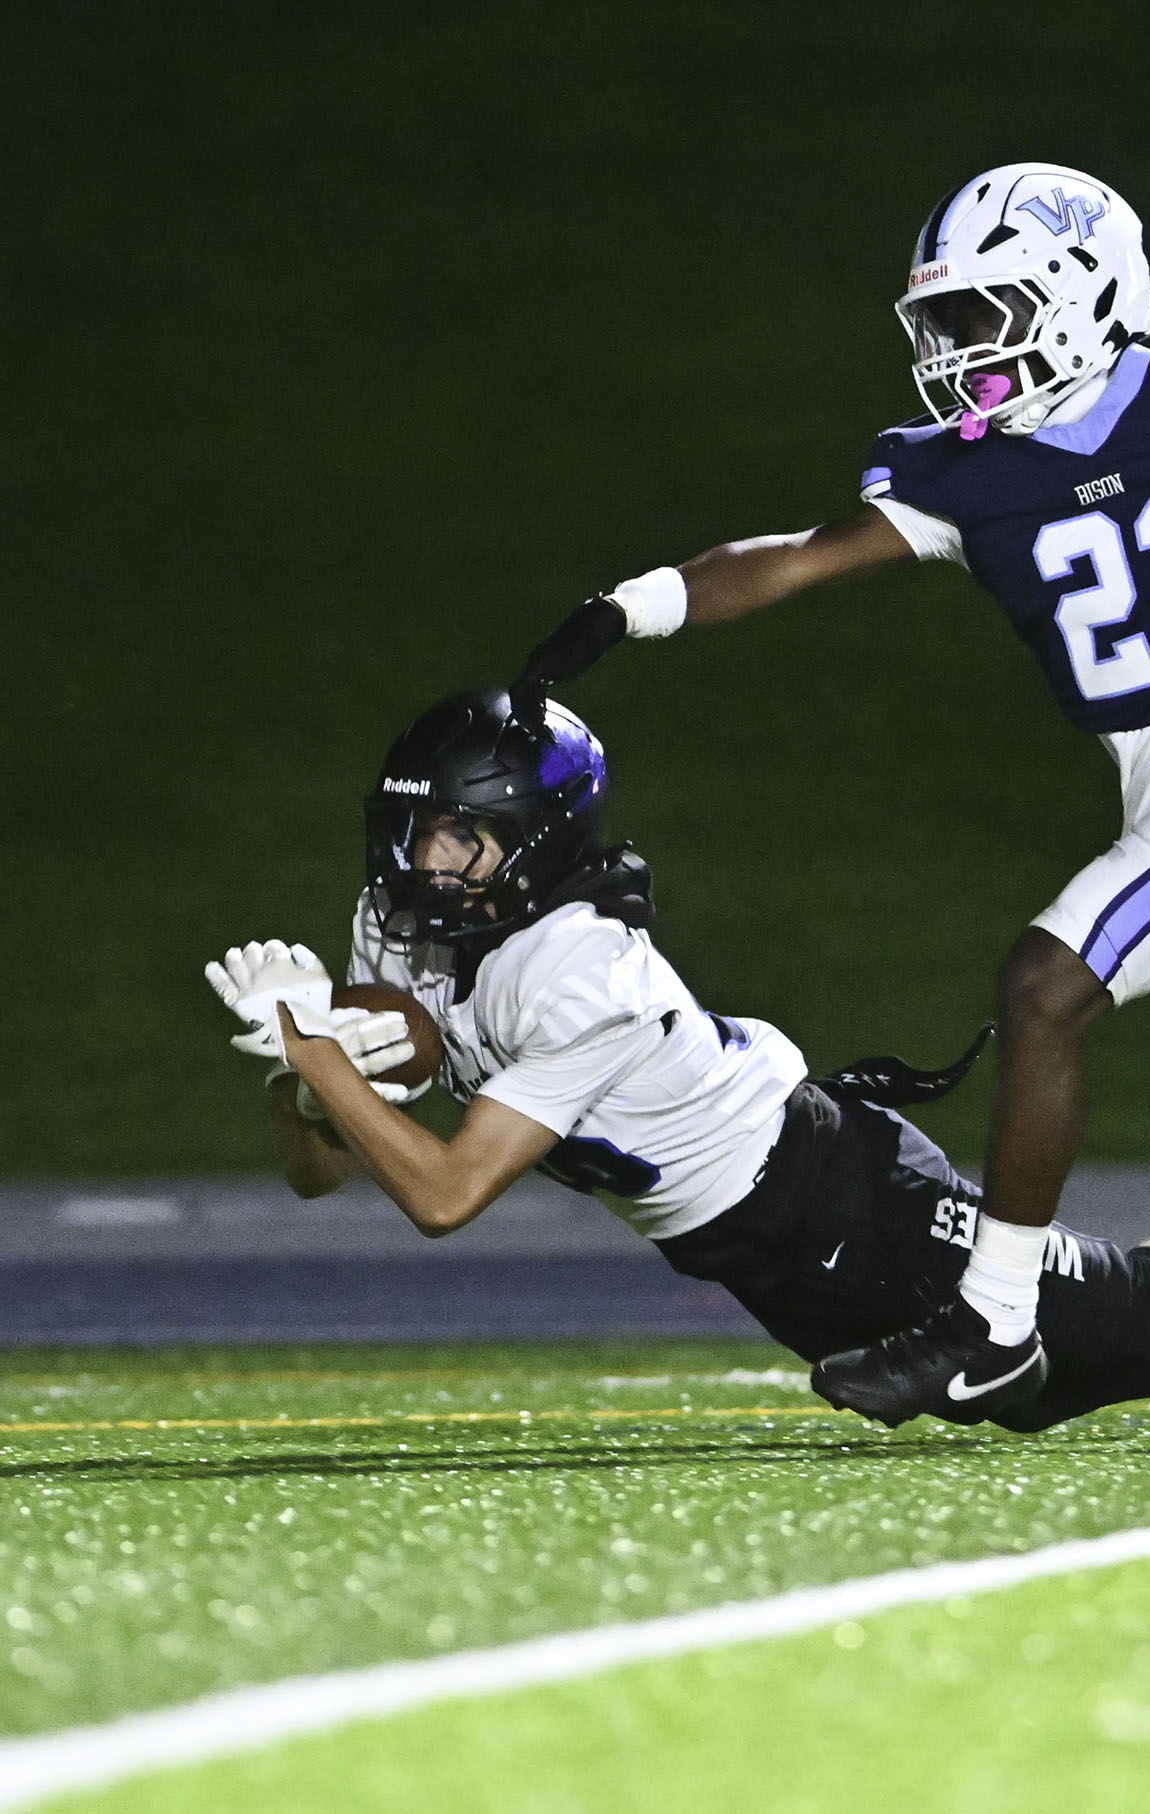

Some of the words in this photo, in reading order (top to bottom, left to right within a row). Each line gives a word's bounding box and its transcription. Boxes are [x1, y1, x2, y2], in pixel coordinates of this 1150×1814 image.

[1015, 187, 1105, 246] VP
[910, 264, 948, 288] Riddell
[1073, 473, 1125, 506] BISON
[383, 777, 431, 796] Riddell
